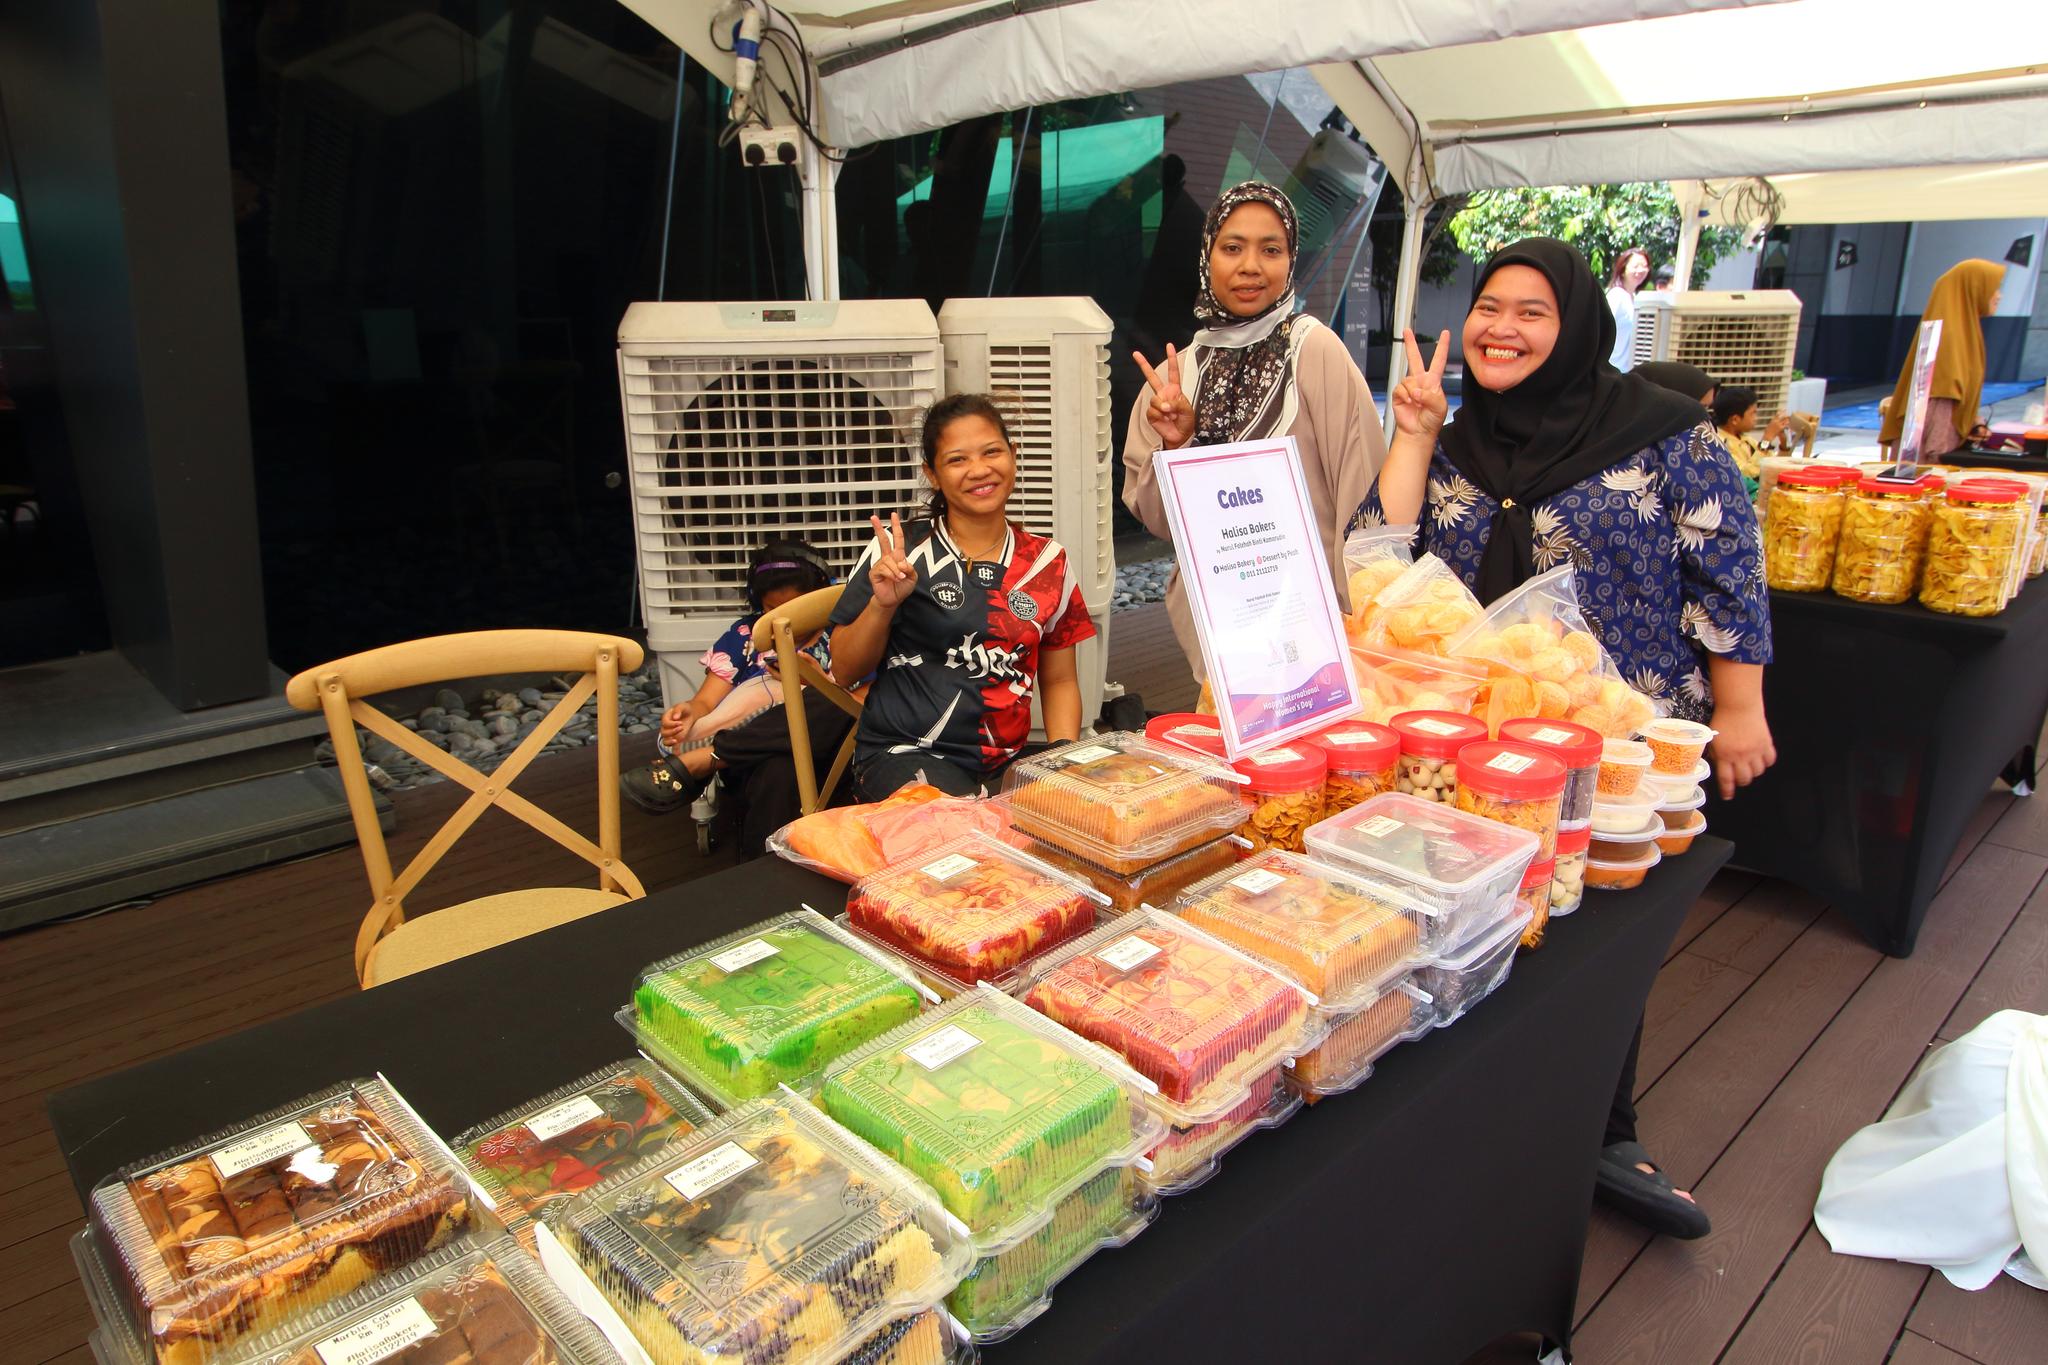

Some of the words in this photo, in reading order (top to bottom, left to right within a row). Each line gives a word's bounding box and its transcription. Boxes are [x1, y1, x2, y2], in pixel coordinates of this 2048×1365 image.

[1217, 487, 1264, 509] Cakes
[1221, 526, 1249, 539] Halisa
[1249, 521, 1276, 534] Bakers
[1220, 562, 1237, 573] Halisa
[1237, 558, 1256, 567] Bakery
[1263, 554, 1281, 562] Dessert
[1281, 551, 1288, 559] by
[1263, 698, 1283, 711] Happy
[1282, 685, 1320, 702] International
[1274, 703, 1301, 718] Women's
[1300, 698, 1314, 710] Day!
[224, 1142, 254, 1154] Marble
[332, 1324, 369, 1344] Marble
[358, 1331, 373, 1340] Rm
[377, 1321, 390, 1330] 23
